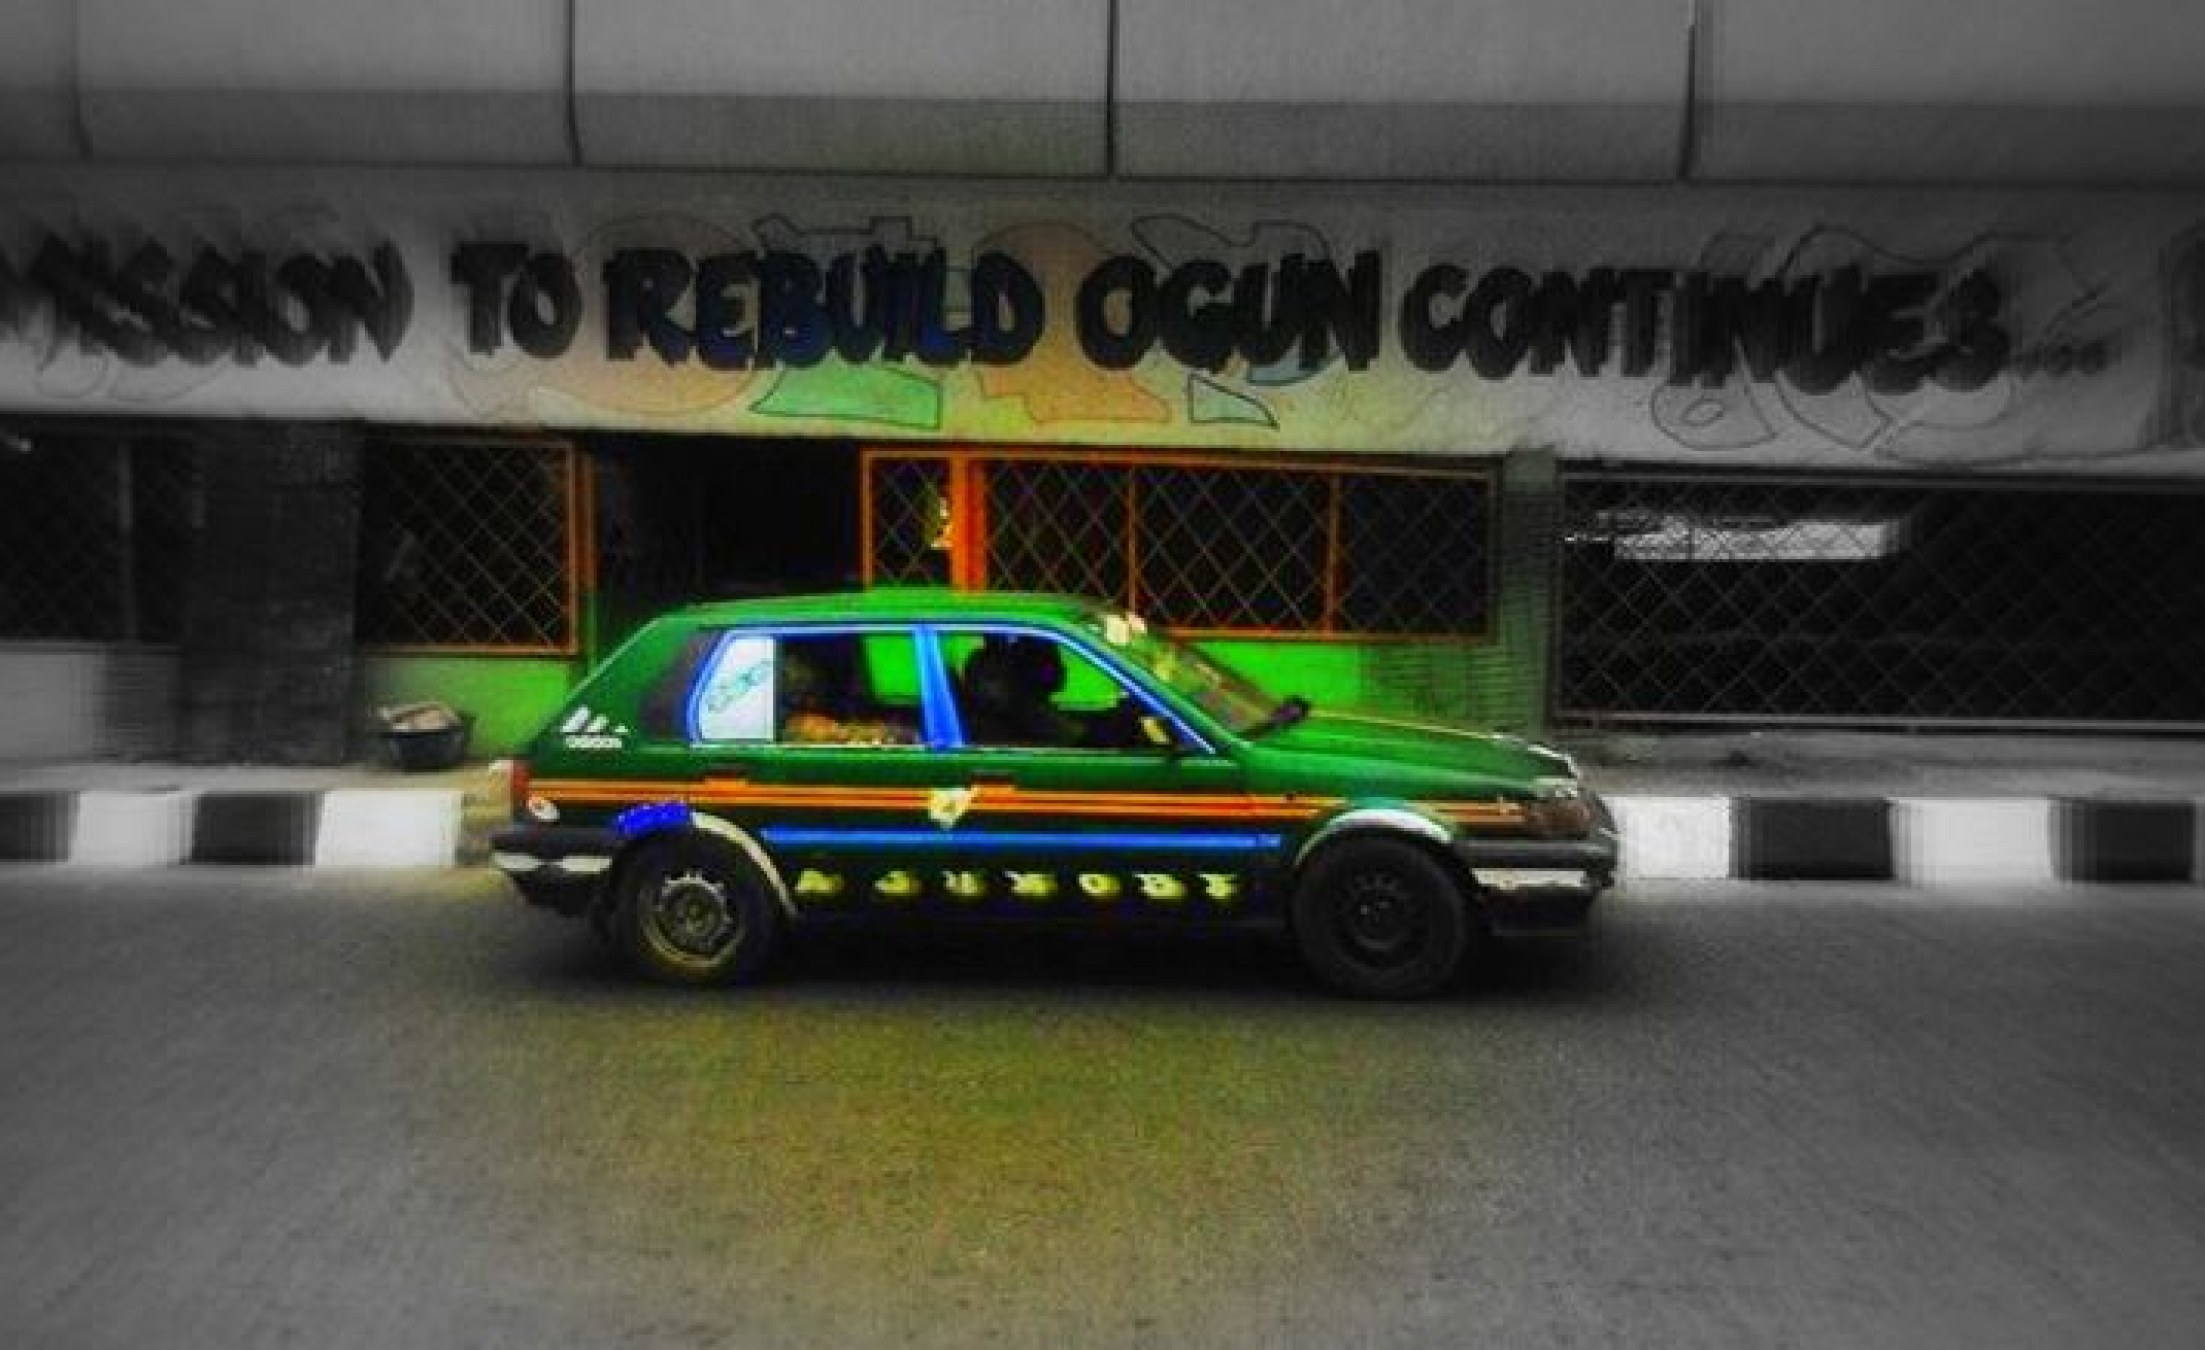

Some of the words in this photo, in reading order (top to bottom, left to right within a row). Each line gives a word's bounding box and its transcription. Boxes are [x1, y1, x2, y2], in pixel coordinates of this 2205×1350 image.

[450, 242, 582, 358] TO
[604, 246, 1044, 370] REBUILD
[1076, 250, 1382, 372] OGUN
